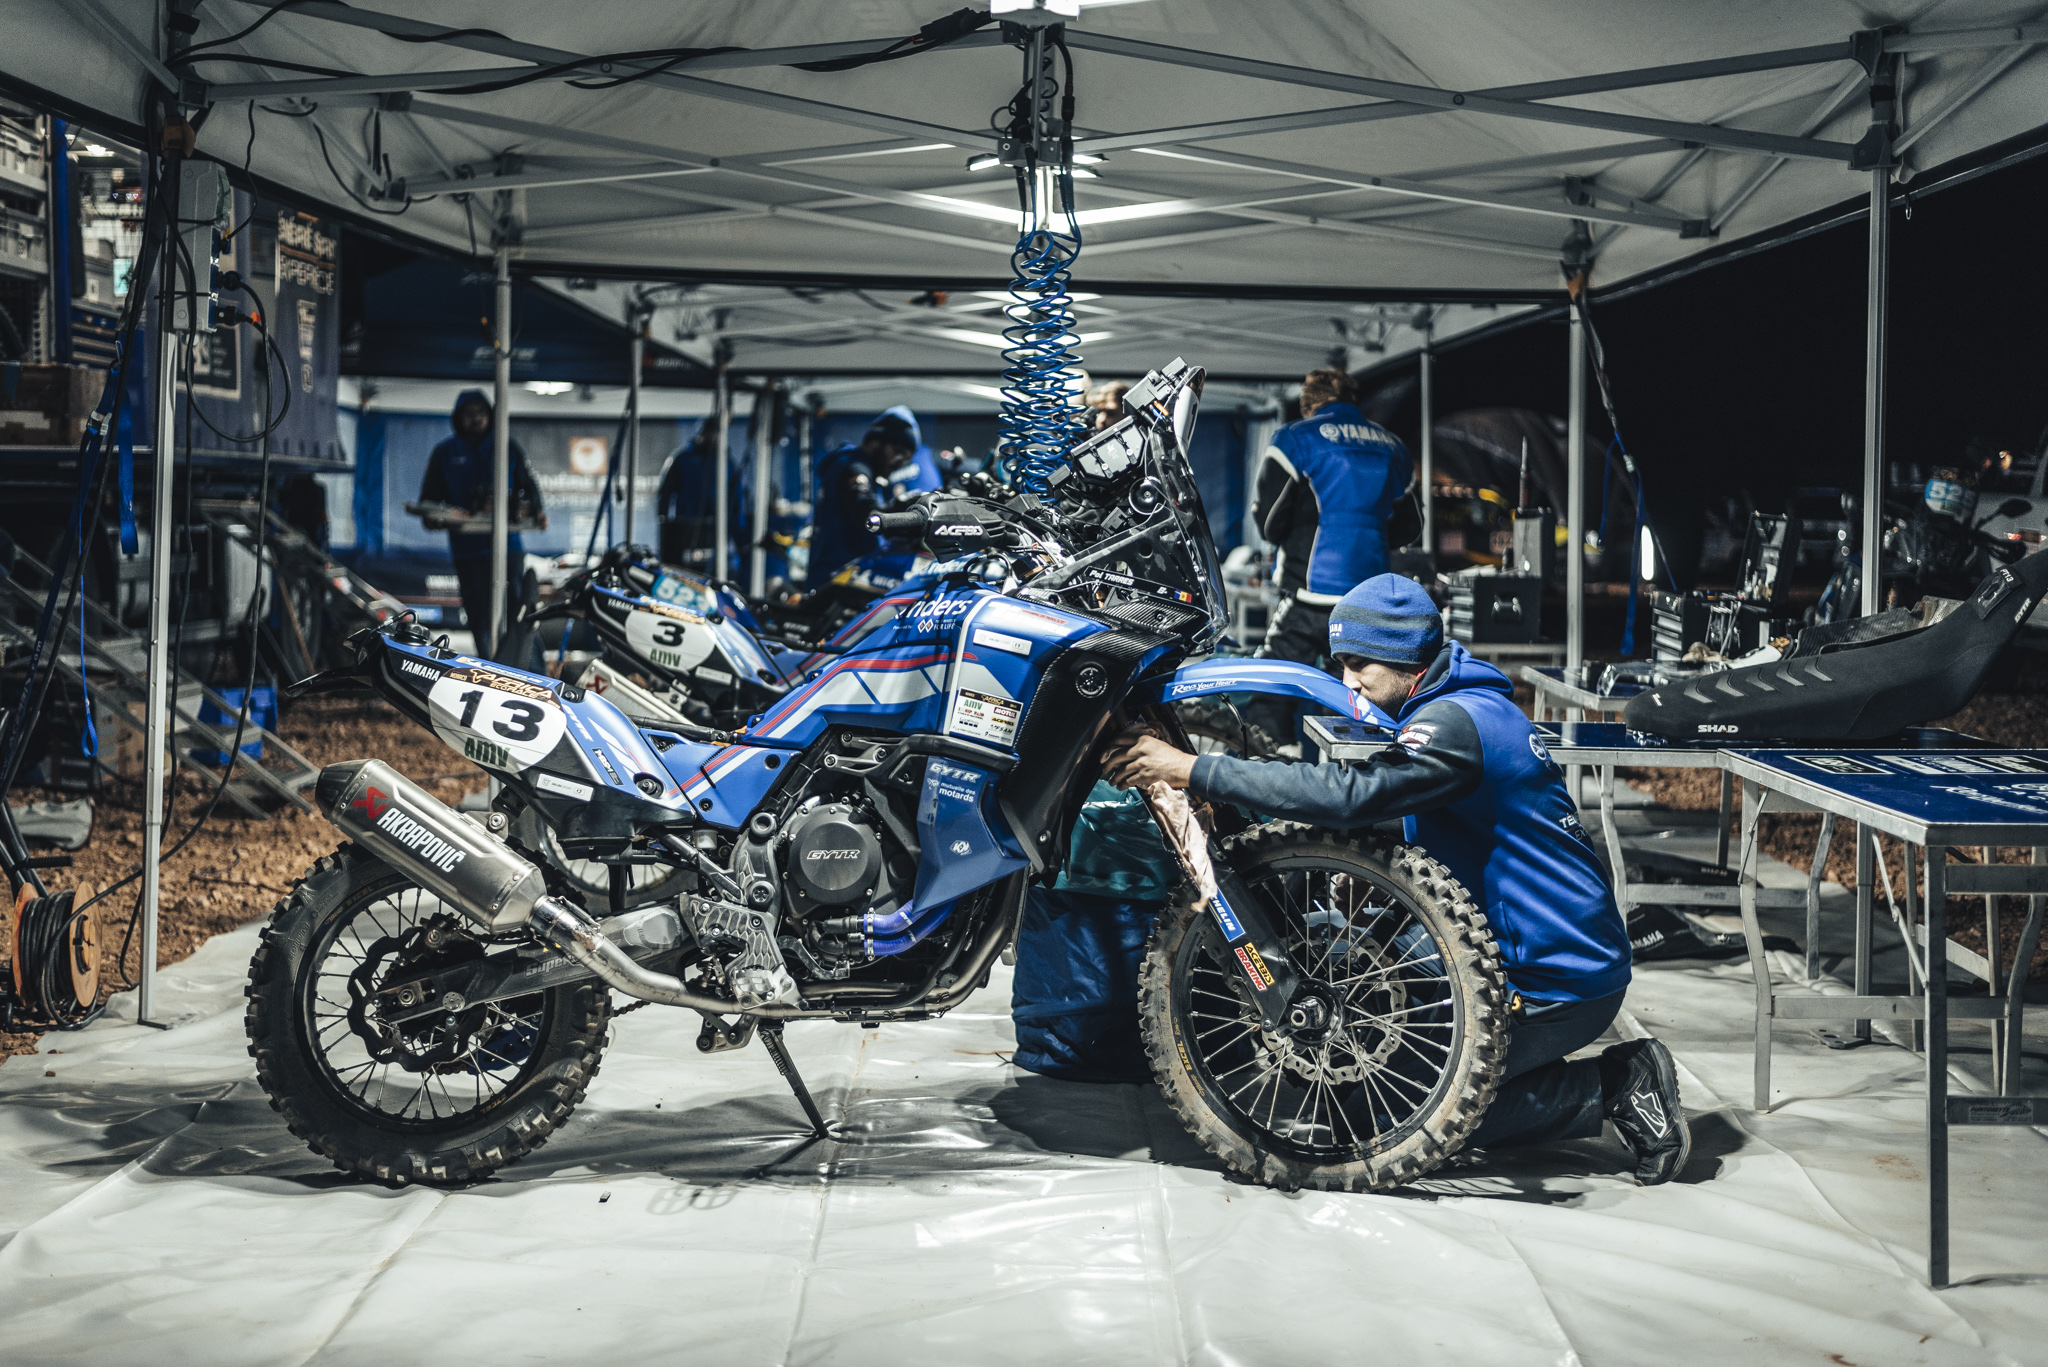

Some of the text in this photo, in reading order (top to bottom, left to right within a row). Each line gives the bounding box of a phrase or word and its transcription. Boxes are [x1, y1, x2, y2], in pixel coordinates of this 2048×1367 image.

[1089, 569, 1103, 579] Pol
[1104, 573, 1135, 586] TARRES
[608, 598, 634, 612] YAMAHA
[652, 620, 686, 647] 3
[401, 659, 441, 682] YAMAHA
[459, 690, 546, 742] 13
[1697, 724, 1739, 733] SHAD
[929, 762, 982, 783] GYTR
[938, 788, 975, 802] motards
[940, 782, 976, 795] mutuelle des
[806, 849, 861, 860] GYTR
[1235, 948, 1266, 990] BRAKING
[1245, 944, 1273, 984] ACERBIS
[1177, 1040, 1193, 1071] EXCEL
